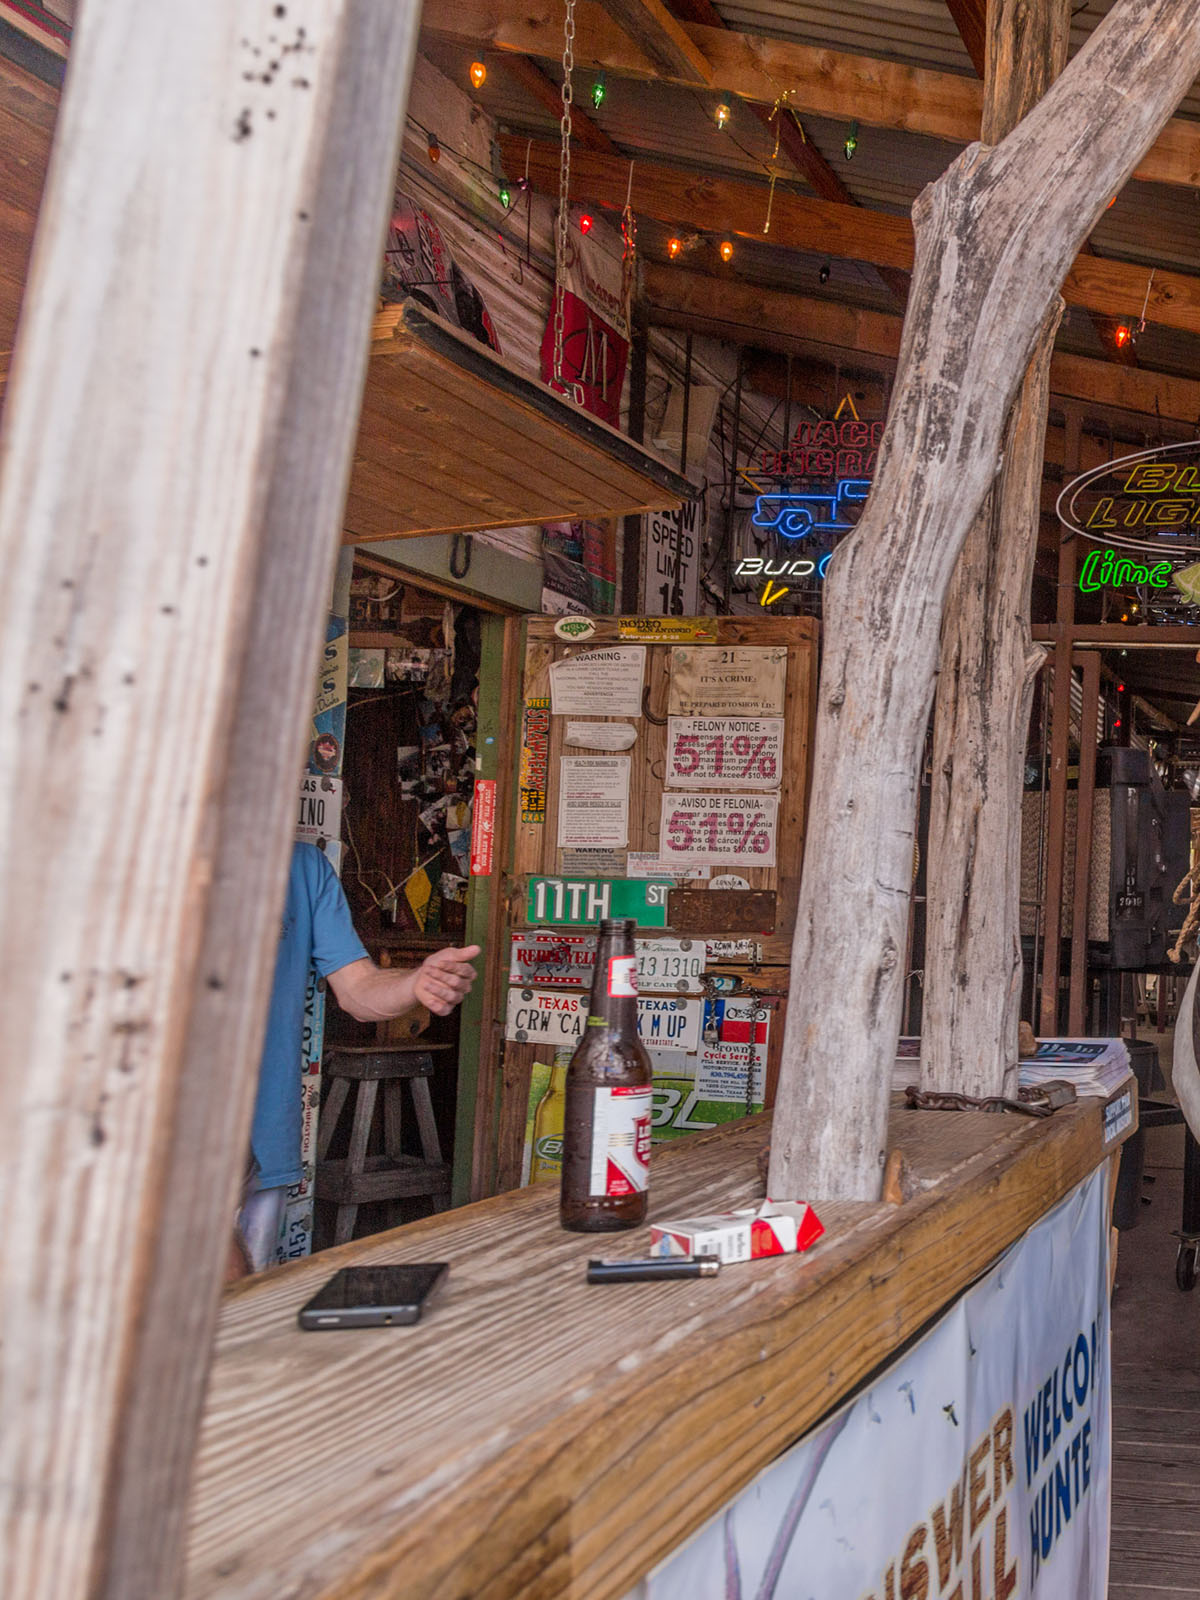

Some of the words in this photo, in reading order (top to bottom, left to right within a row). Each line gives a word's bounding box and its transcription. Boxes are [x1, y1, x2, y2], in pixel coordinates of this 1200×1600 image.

[762, 450, 877, 475] INGR
[657, 552, 688, 584] LIMT
[735, 558, 815, 575] BUD
[1080, 550, 1172, 592] Lime
[620, 620, 661, 628] RODEO
[576, 652, 620, 661] WARNING
[721, 652, 736, 663] 21
[693, 721, 726, 731] FELONY
[728, 722, 760, 732] NOTICE
[527, 709, 549, 793] STRAWBERRY
[673, 736, 776, 777] 51%
[710, 799, 721, 808] DE
[666, 818, 695, 826] licencia
[673, 810, 700, 819] Cargar
[666, 812, 770, 854] 51%
[536, 881, 609, 919] 11TH
[648, 885, 668, 904] ST
[662, 957, 700, 977] 1310
[538, 997, 578, 1011] TEXAS
[638, 1000, 677, 1011] TEXAS
[515, 1009, 551, 1032] CRW
[561, 1013, 587, 1035] CA
[651, 1014, 660, 1037] M
[667, 1015, 687, 1038] UP
[704, 1051, 726, 1059] Cycle
[730, 1053, 760, 1061] Servce
[866, 1408, 1014, 1600] SWER
[1030, 1418, 1091, 1595] HUNTE
